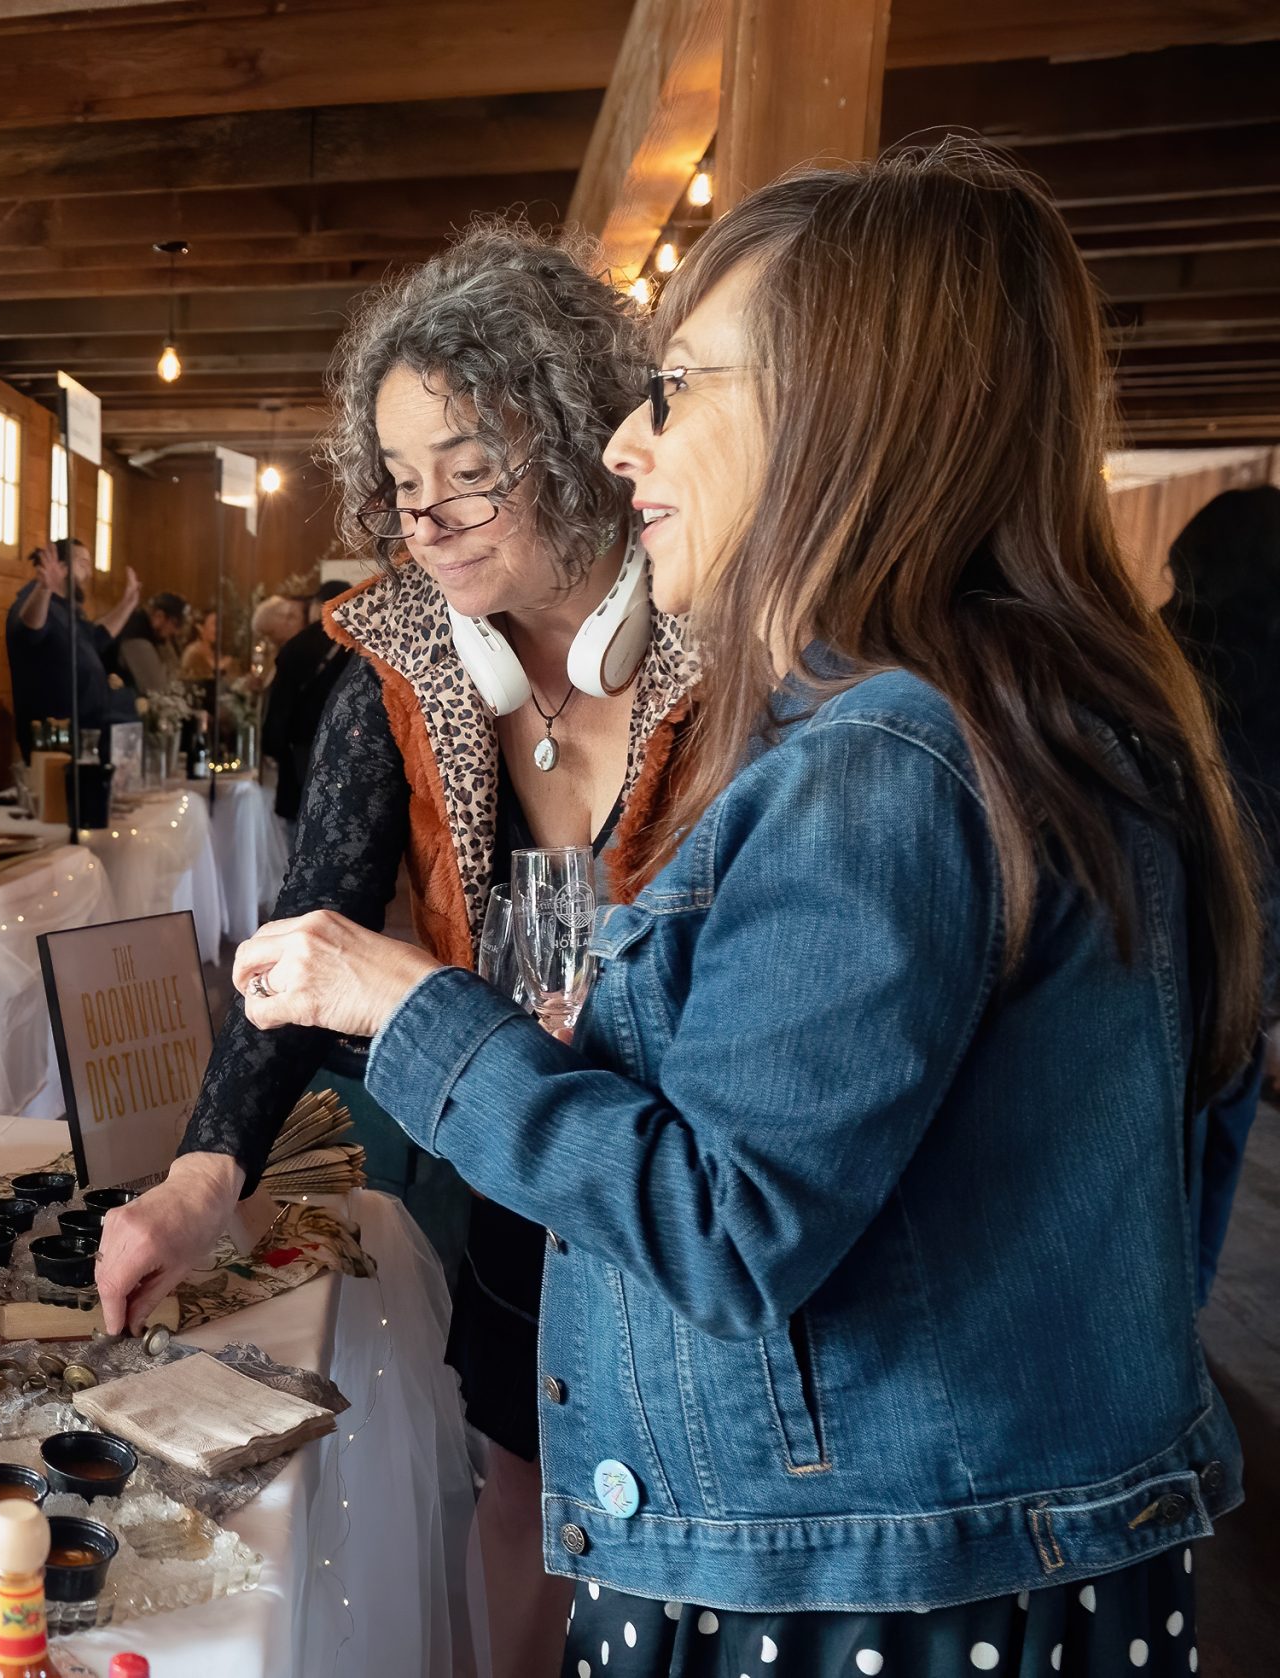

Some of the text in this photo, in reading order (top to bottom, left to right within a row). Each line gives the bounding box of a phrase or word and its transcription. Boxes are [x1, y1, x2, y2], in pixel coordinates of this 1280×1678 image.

[112, 945, 136, 982] THE
[81, 975, 187, 1050] BOONVILLE
[85, 1036, 201, 1124] DISTILLERY
